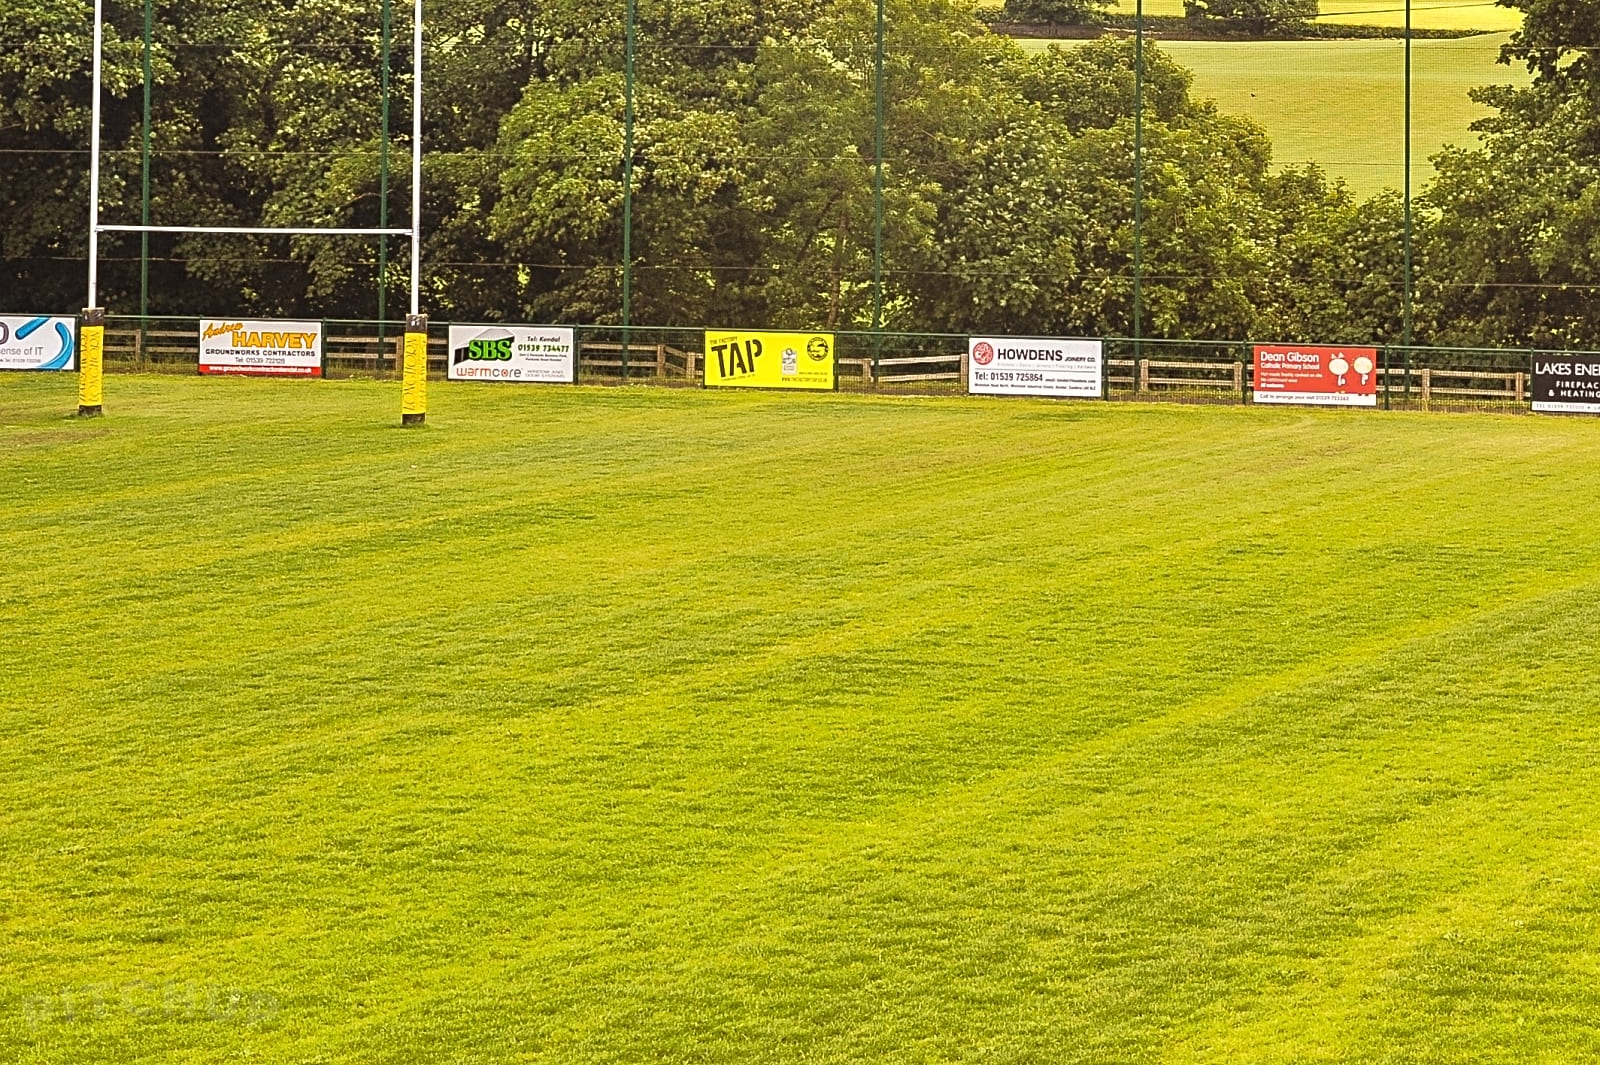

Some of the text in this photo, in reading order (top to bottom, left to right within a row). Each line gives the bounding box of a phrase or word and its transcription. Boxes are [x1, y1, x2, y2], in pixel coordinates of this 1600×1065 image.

[202, 322, 243, 341] Andrew
[232, 331, 317, 349] HARVEY
[24, 347, 32, 356] of
[35, 346, 44, 355] IT
[205, 348, 315, 357] GROUNDWORKS CONTRACTORS
[468, 339, 512, 361] SBS
[517, 344, 540, 352] 01539
[711, 339, 763, 377] TAP
[997, 348, 1063, 361] HOWDENS
[1260, 351, 1319, 363] Dean Gibson
[456, 367, 522, 378] warmcore
[1535, 362, 1571, 375] LAKES
[974, 371, 988, 380] Tel:
[990, 372, 1013, 381] 01539
